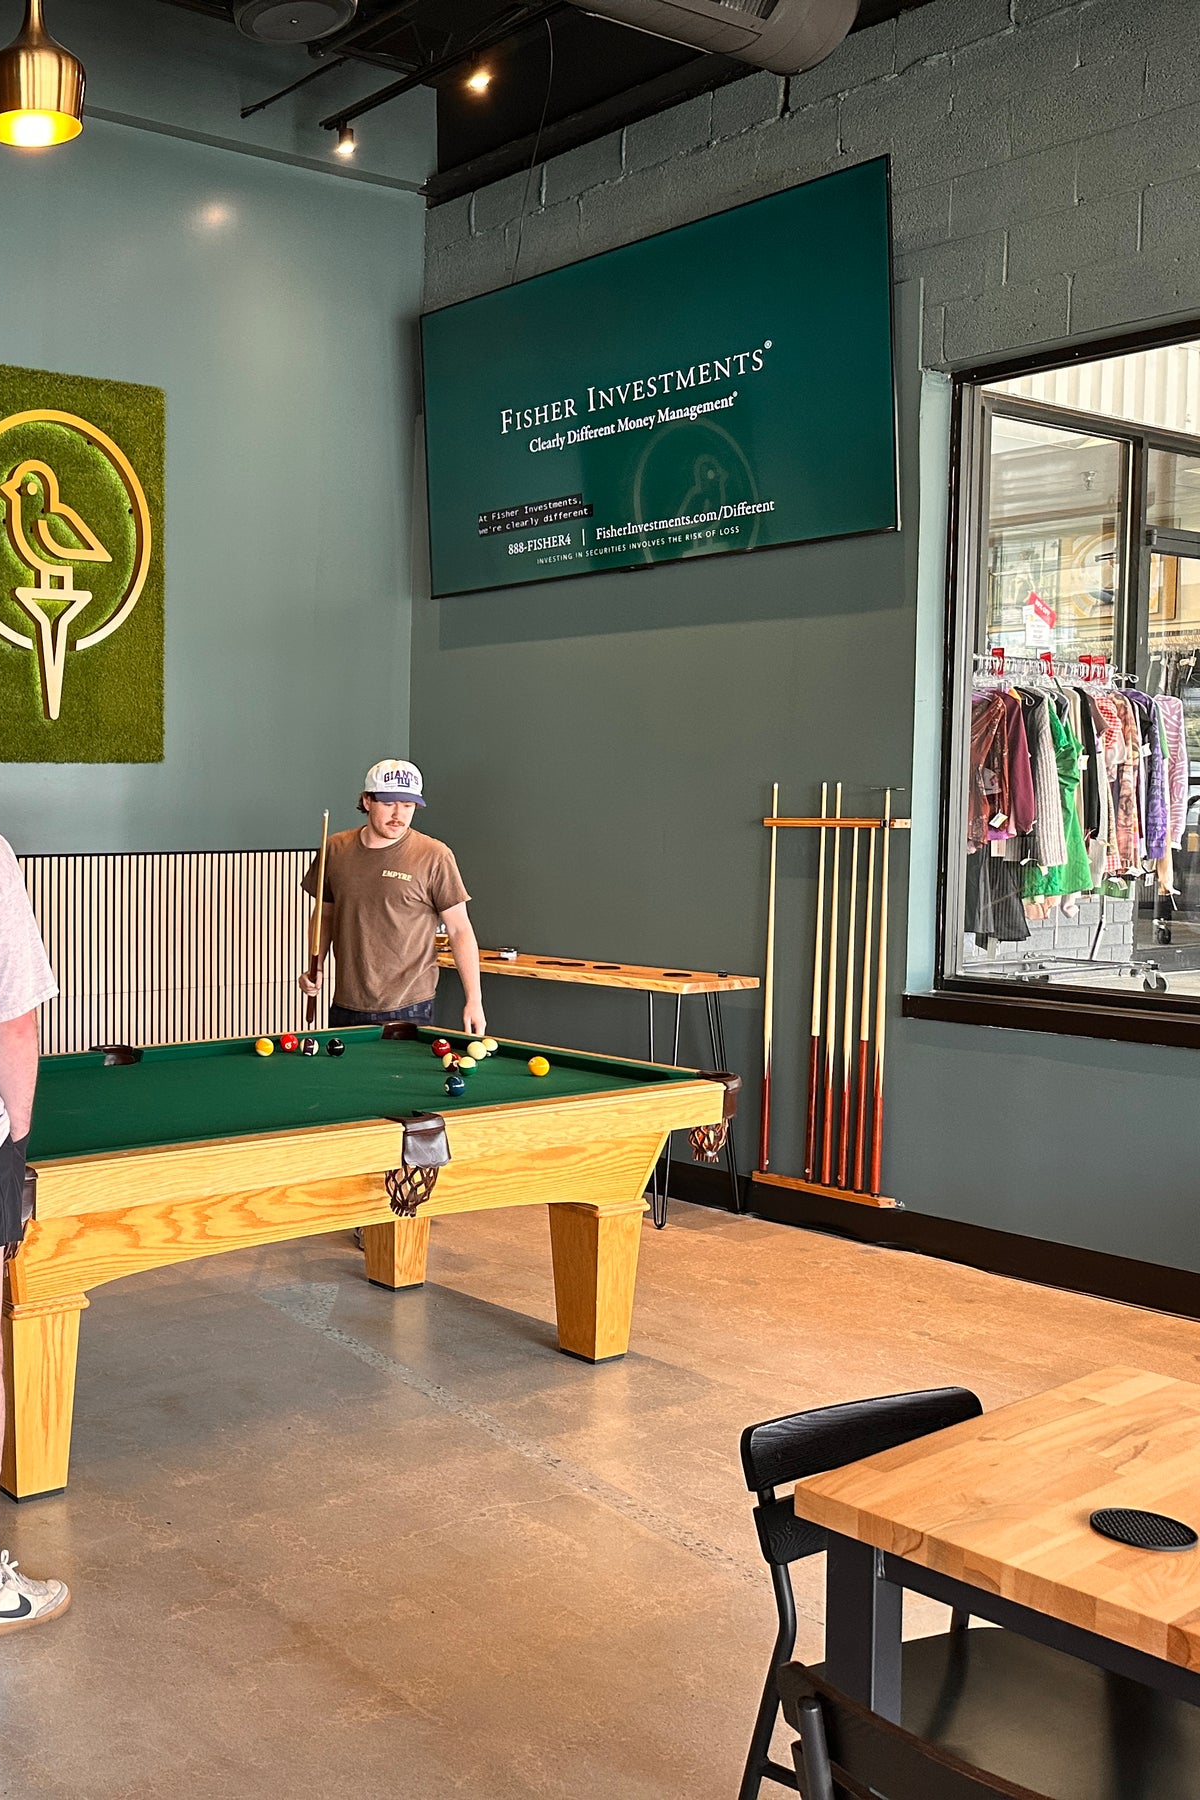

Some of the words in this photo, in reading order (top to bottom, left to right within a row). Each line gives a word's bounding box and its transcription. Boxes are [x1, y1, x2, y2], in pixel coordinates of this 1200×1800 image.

[501, 399, 577, 434] FISHER
[530, 433, 565, 452] Clearly
[567, 424, 615, 444] Different
[617, 415, 655, 432] Money
[478, 515, 489, 523] At
[491, 509, 520, 520] Fisher
[525, 498, 581, 513] Investments,
[478, 525, 502, 535] we're
[505, 517, 539, 530] clearly
[509, 533, 571, 554] 888-FISHER4
[597, 501, 774, 539] FisherInvestments.com/Different
[537, 553, 572, 563] INVESTING
[586, 544, 626, 557] SECURITIES
[630, 538, 664, 549] INVOLVES
[668, 534, 682, 543] THE
[685, 531, 703, 541] RISK
[705, 529, 716, 538] OF
[719, 525, 740, 536] LOSS
[384, 770, 419, 786] GIANTS
[382, 870, 412, 881] EMPYRE
